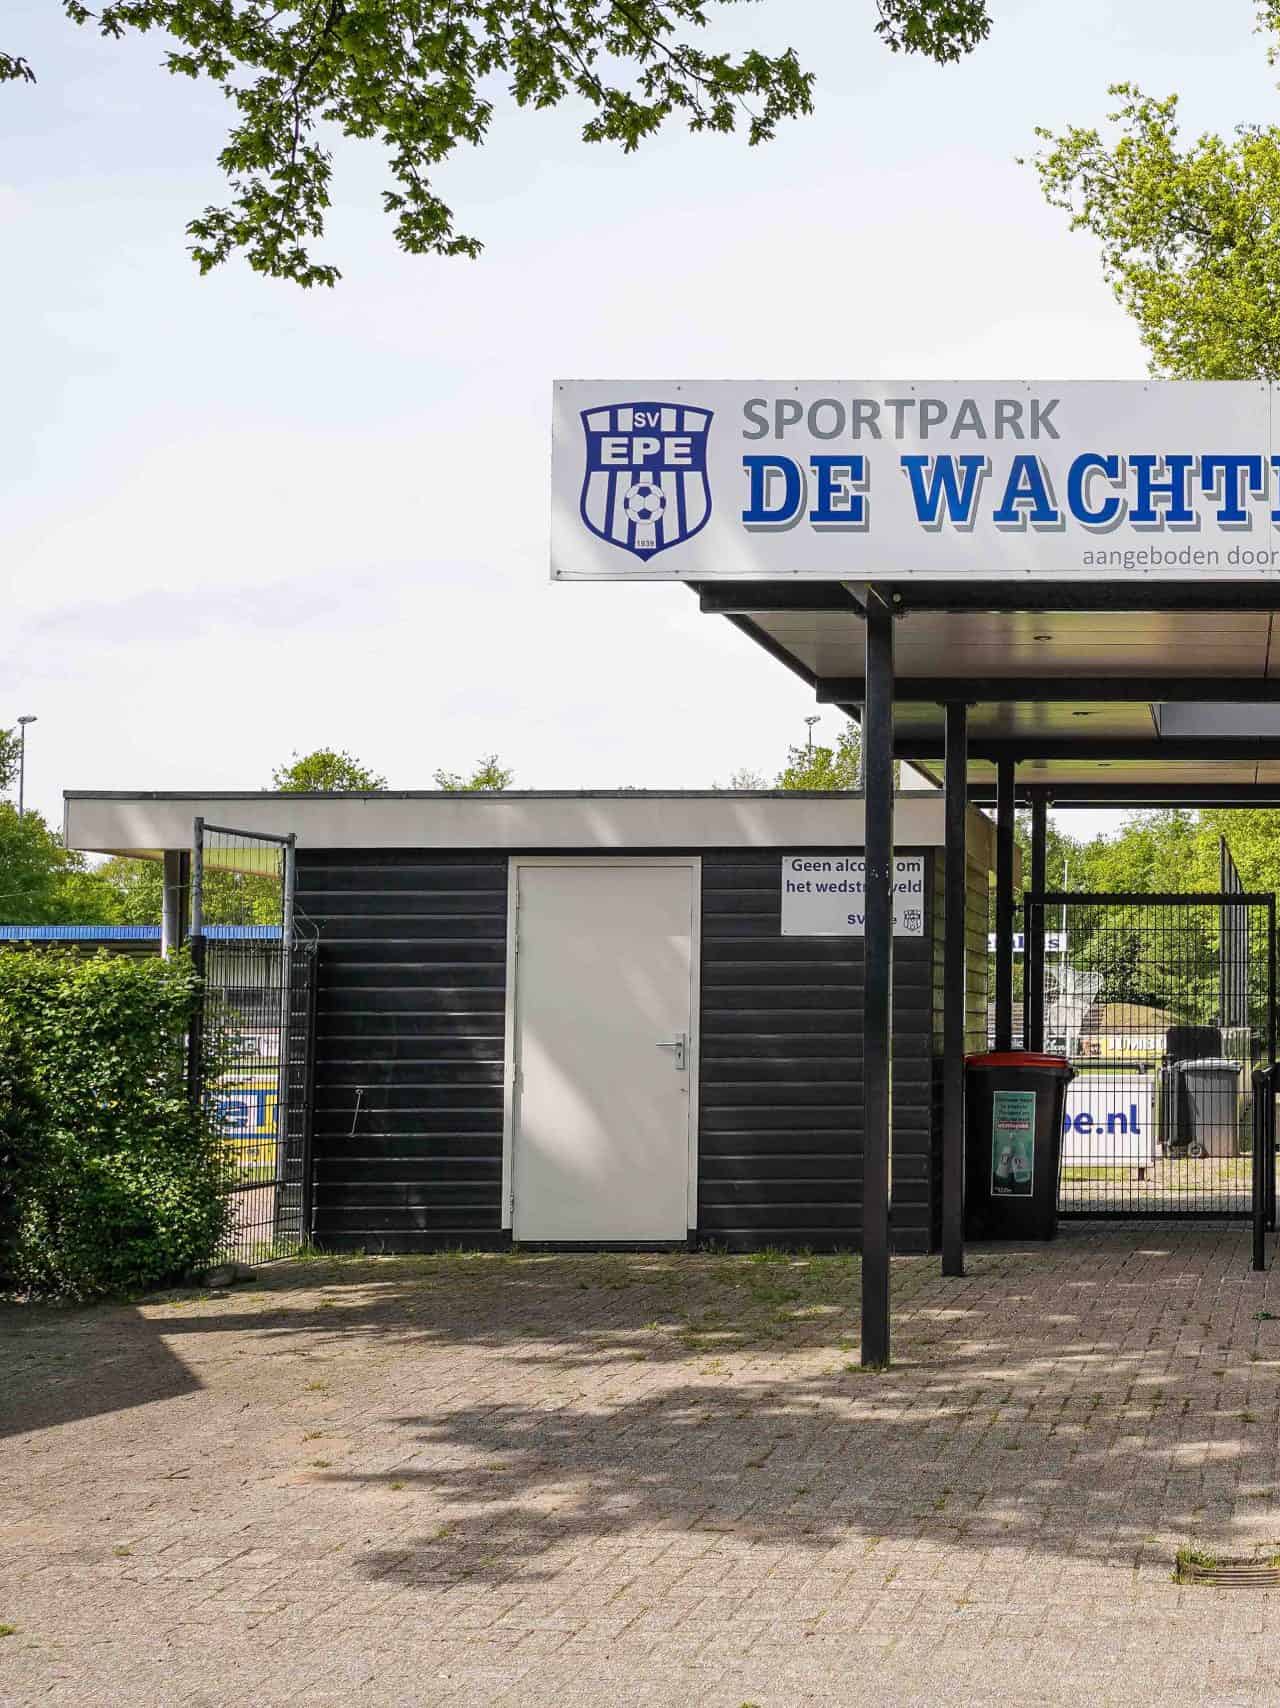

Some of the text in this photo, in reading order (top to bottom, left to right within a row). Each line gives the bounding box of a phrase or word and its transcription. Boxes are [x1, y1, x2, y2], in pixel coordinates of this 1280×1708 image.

[633, 410, 660, 428] SV
[741, 397, 1061, 441] SPORTPARK
[600, 435, 694, 467] EPE
[741, 454, 872, 533] DE
[1083, 546, 1220, 570] aangeboden
[1227, 546, 1280, 566] door
[791, 858, 832, 872] Geen
[786, 880, 811, 893] het
